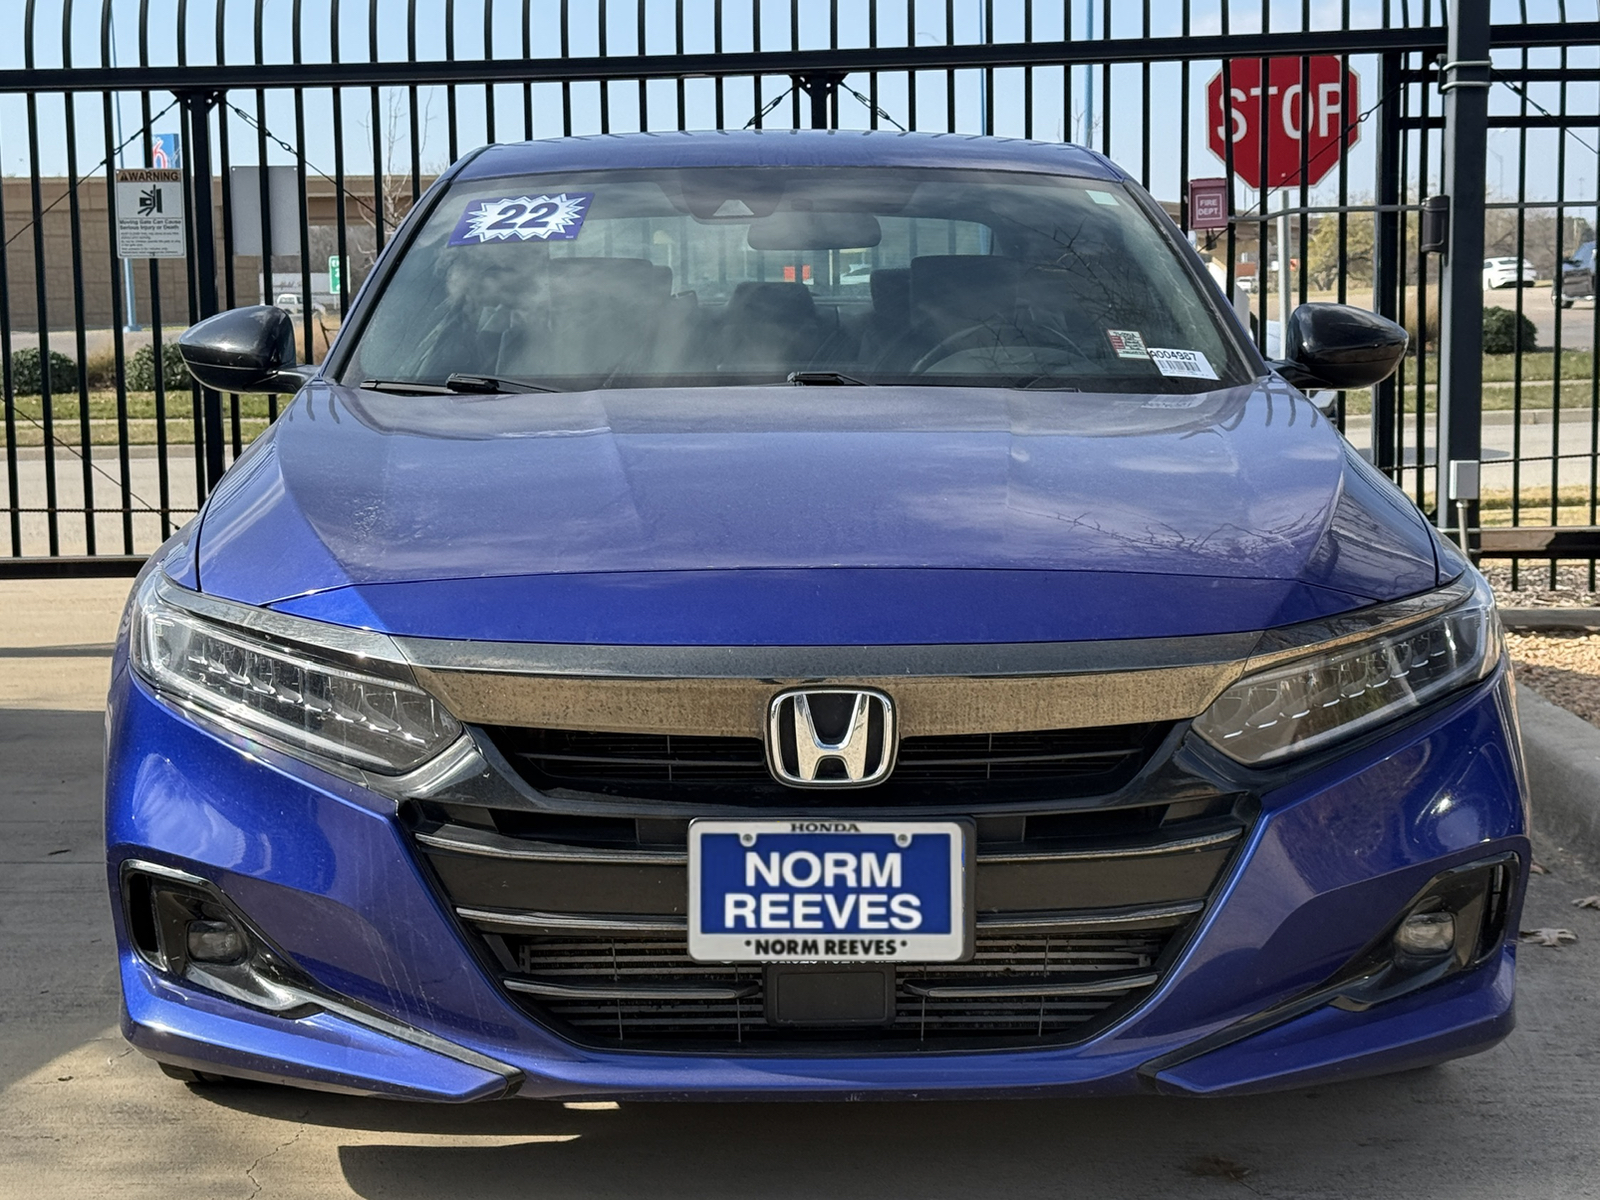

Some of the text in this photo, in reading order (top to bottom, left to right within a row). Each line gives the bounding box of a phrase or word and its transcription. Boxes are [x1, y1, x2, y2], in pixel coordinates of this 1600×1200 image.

[1217, 83, 1342, 143] SOP
[128, 171, 179, 181] WARNING
[1200, 199, 1218, 207] FIRE
[485, 202, 560, 231] 22
[790, 823, 861, 833] HONDA
[745, 851, 902, 888] NORM
[724, 893, 923, 931] REEVES
[754, 939, 898, 956] NORM REEVES
